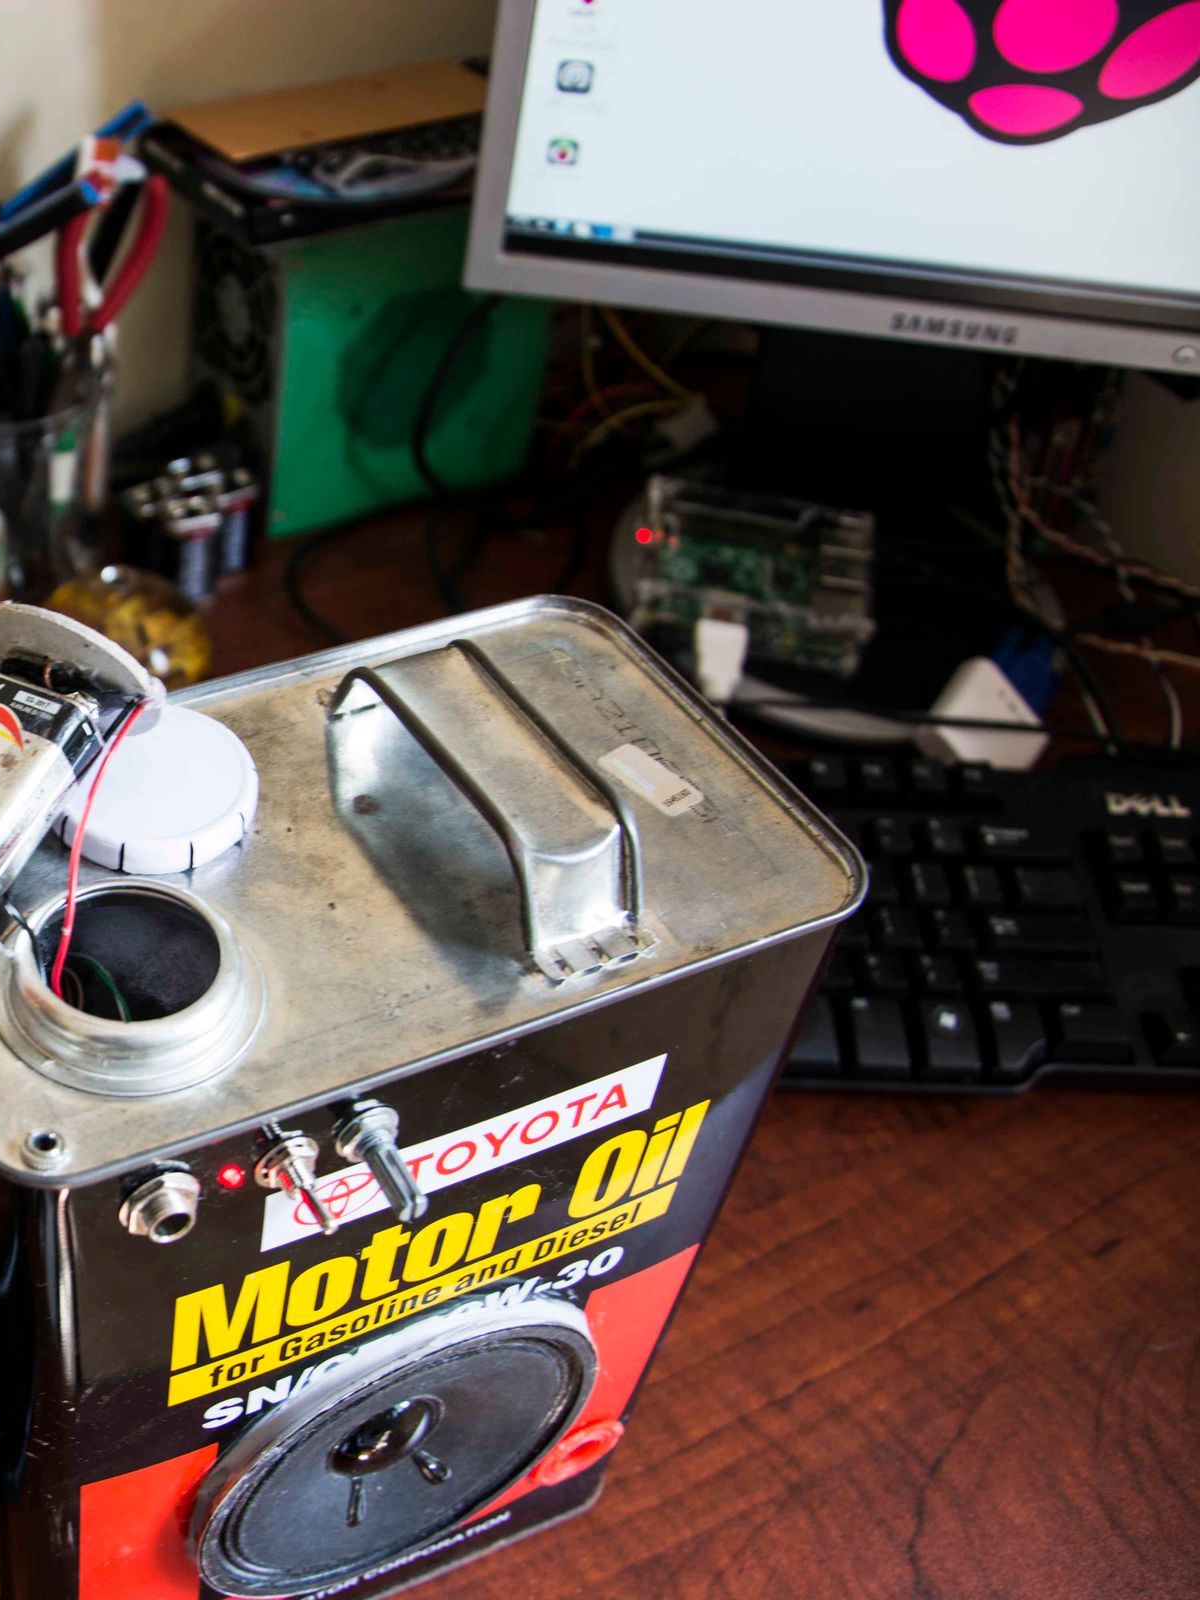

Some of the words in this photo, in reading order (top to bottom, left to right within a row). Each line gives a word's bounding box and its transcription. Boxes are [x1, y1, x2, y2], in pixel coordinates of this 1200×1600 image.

[890, 311, 1019, 344] SAMSUNG
[1106, 792, 1191, 819] DELL
[405, 1083, 629, 1177] TOYOTA
[170, 1184, 542, 1372] Motor
[568, 1099, 711, 1219] Oil
[209, 1354, 265, 1388] for
[279, 1284, 443, 1362] Gasoline
[454, 1251, 522, 1293] and
[533, 1202, 641, 1263] Diesel
